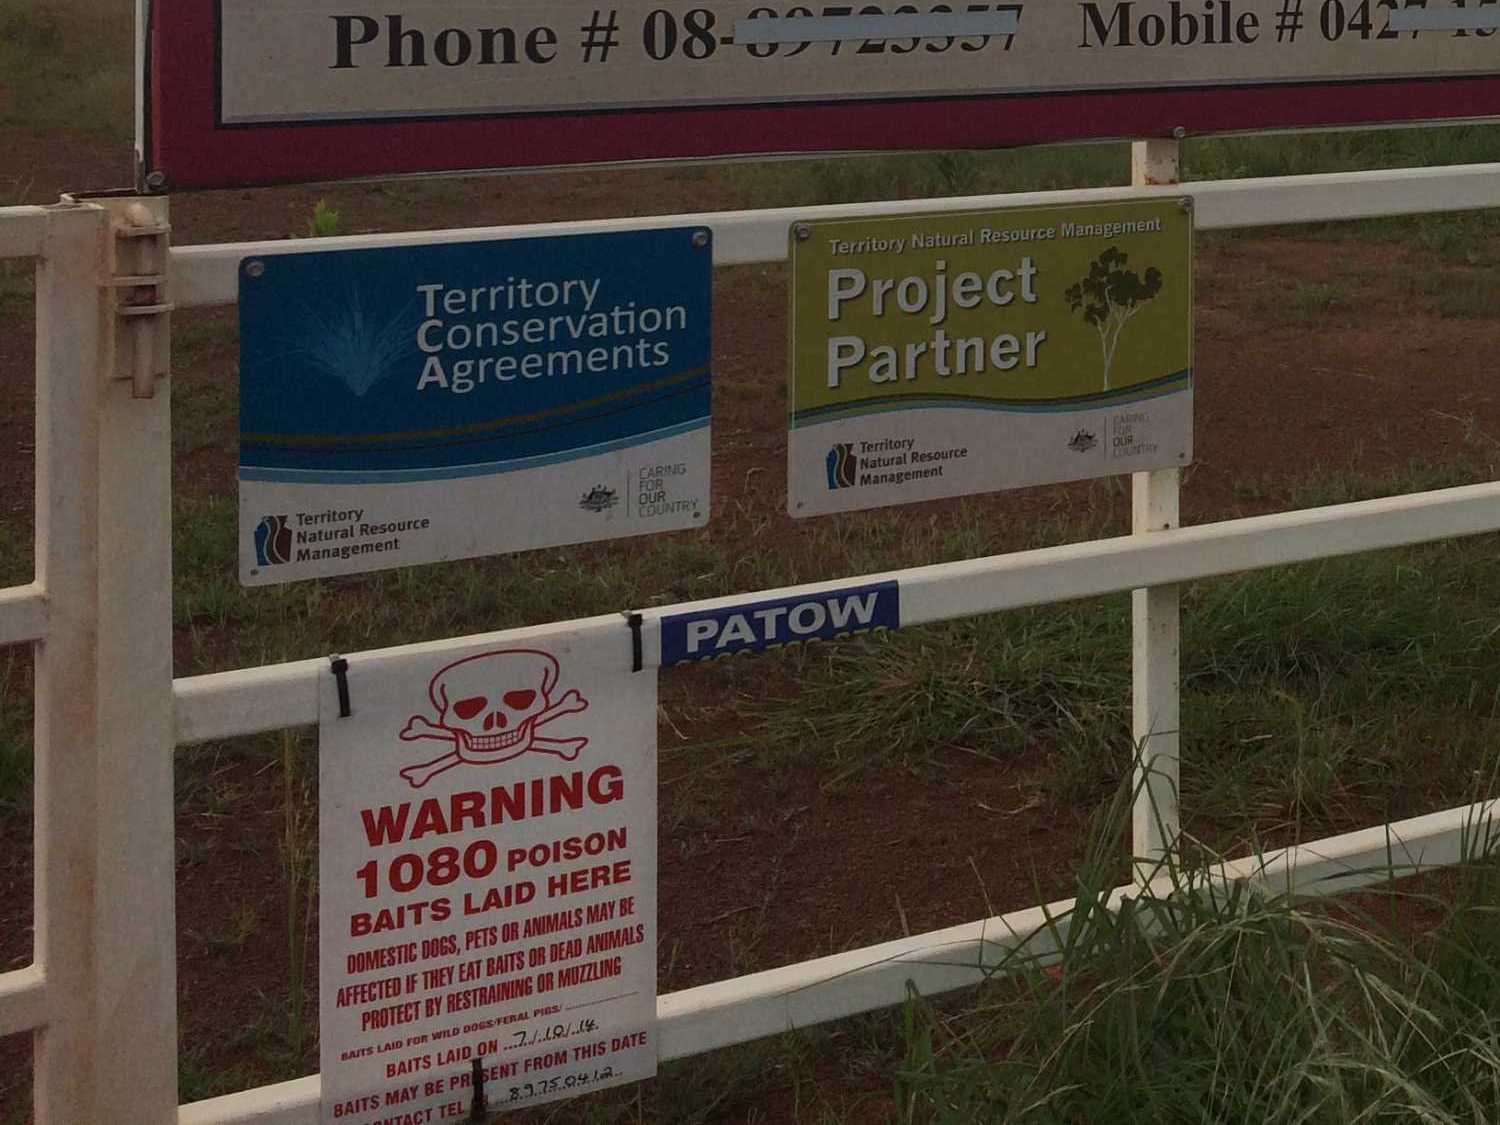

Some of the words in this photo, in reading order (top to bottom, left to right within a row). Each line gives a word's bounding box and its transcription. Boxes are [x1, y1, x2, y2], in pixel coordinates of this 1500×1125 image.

[330, 13, 557, 69] Phone
[581, 10, 620, 63] #
[1274, 0, 1304, 43] #
[829, 238, 905, 256] Territory
[912, 230, 973, 248] Natural
[980, 225, 1055, 243] Resource
[1062, 217, 1161, 238] Management
[417, 277, 601, 318] Territory
[827, 257, 1037, 324] Project
[417, 302, 686, 353] Conservation
[417, 339, 670, 394] Agreements
[826, 329, 1047, 388] Partner
[860, 436, 915, 453] Territory
[860, 452, 907, 470] Natural
[911, 445, 968, 463] Resource
[1113, 435, 1133, 447] OUR
[640, 463, 687, 479] CARING
[640, 478, 663, 491] FOR
[860, 464, 943, 486] Management
[296, 508, 364, 527] Territory
[639, 499, 698, 517] COUNTRY
[640, 491, 666, 505] OUR
[296, 525, 355, 544] Natural
[360, 517, 429, 537] Resource
[296, 538, 400, 563] Management
[687, 592, 878, 653] PATOW
[361, 765, 624, 847] WARNING
[356, 839, 497, 899] 1080
[508, 826, 627, 872] POISON
[351, 897, 451, 937] BAITS
[464, 881, 536, 916] LAID
[548, 860, 631, 898] HERE
[347, 941, 417, 974] DOMESTIC
[422, 935, 461, 960] DOGS,
[466, 926, 497, 951] PETS
[502, 922, 519, 943] OR
[523, 908, 582, 939] ANIMALS
[586, 901, 617, 924] MAY
[619, 895, 635, 917] BE
[336, 976, 402, 1008] AFFECTED
[406, 973, 418, 994] IF
[422, 965, 453, 990] THEY
[459, 959, 482, 983] EAT
[486, 949, 525, 977] BAITS
[529, 946, 546, 967] OR
[550, 936, 582, 962] DEAD
[586, 923, 645, 954] ANIMALS
[361, 1003, 420, 1031] PROTECT
[426, 997, 442, 1018] BY
[447, 974, 533, 1013] RESTRAINING
[536, 972, 554, 993] OR
[557, 956, 622, 989] MUZZLING
[341, 1047, 374, 1061] BAITS
[377, 1040, 403, 1054] LAID
[406, 1033, 428, 1047] FOR
[432, 1027, 460, 1043] WILD
[386, 1057, 432, 1078] BAITS
[437, 1047, 472, 1067] LAID
[477, 1038, 498, 1057] ON
[334, 1094, 381, 1118] BAITS
[385, 1085, 420, 1106] MAY
[424, 1079, 446, 1097] BE
[449, 1062, 519, 1091] PRSENT
[524, 1051, 568, 1075] FROM
[572, 1039, 608, 1061] THIS
[611, 1030, 648, 1054] DATE
[438, 1101, 466, 1119] TEL
